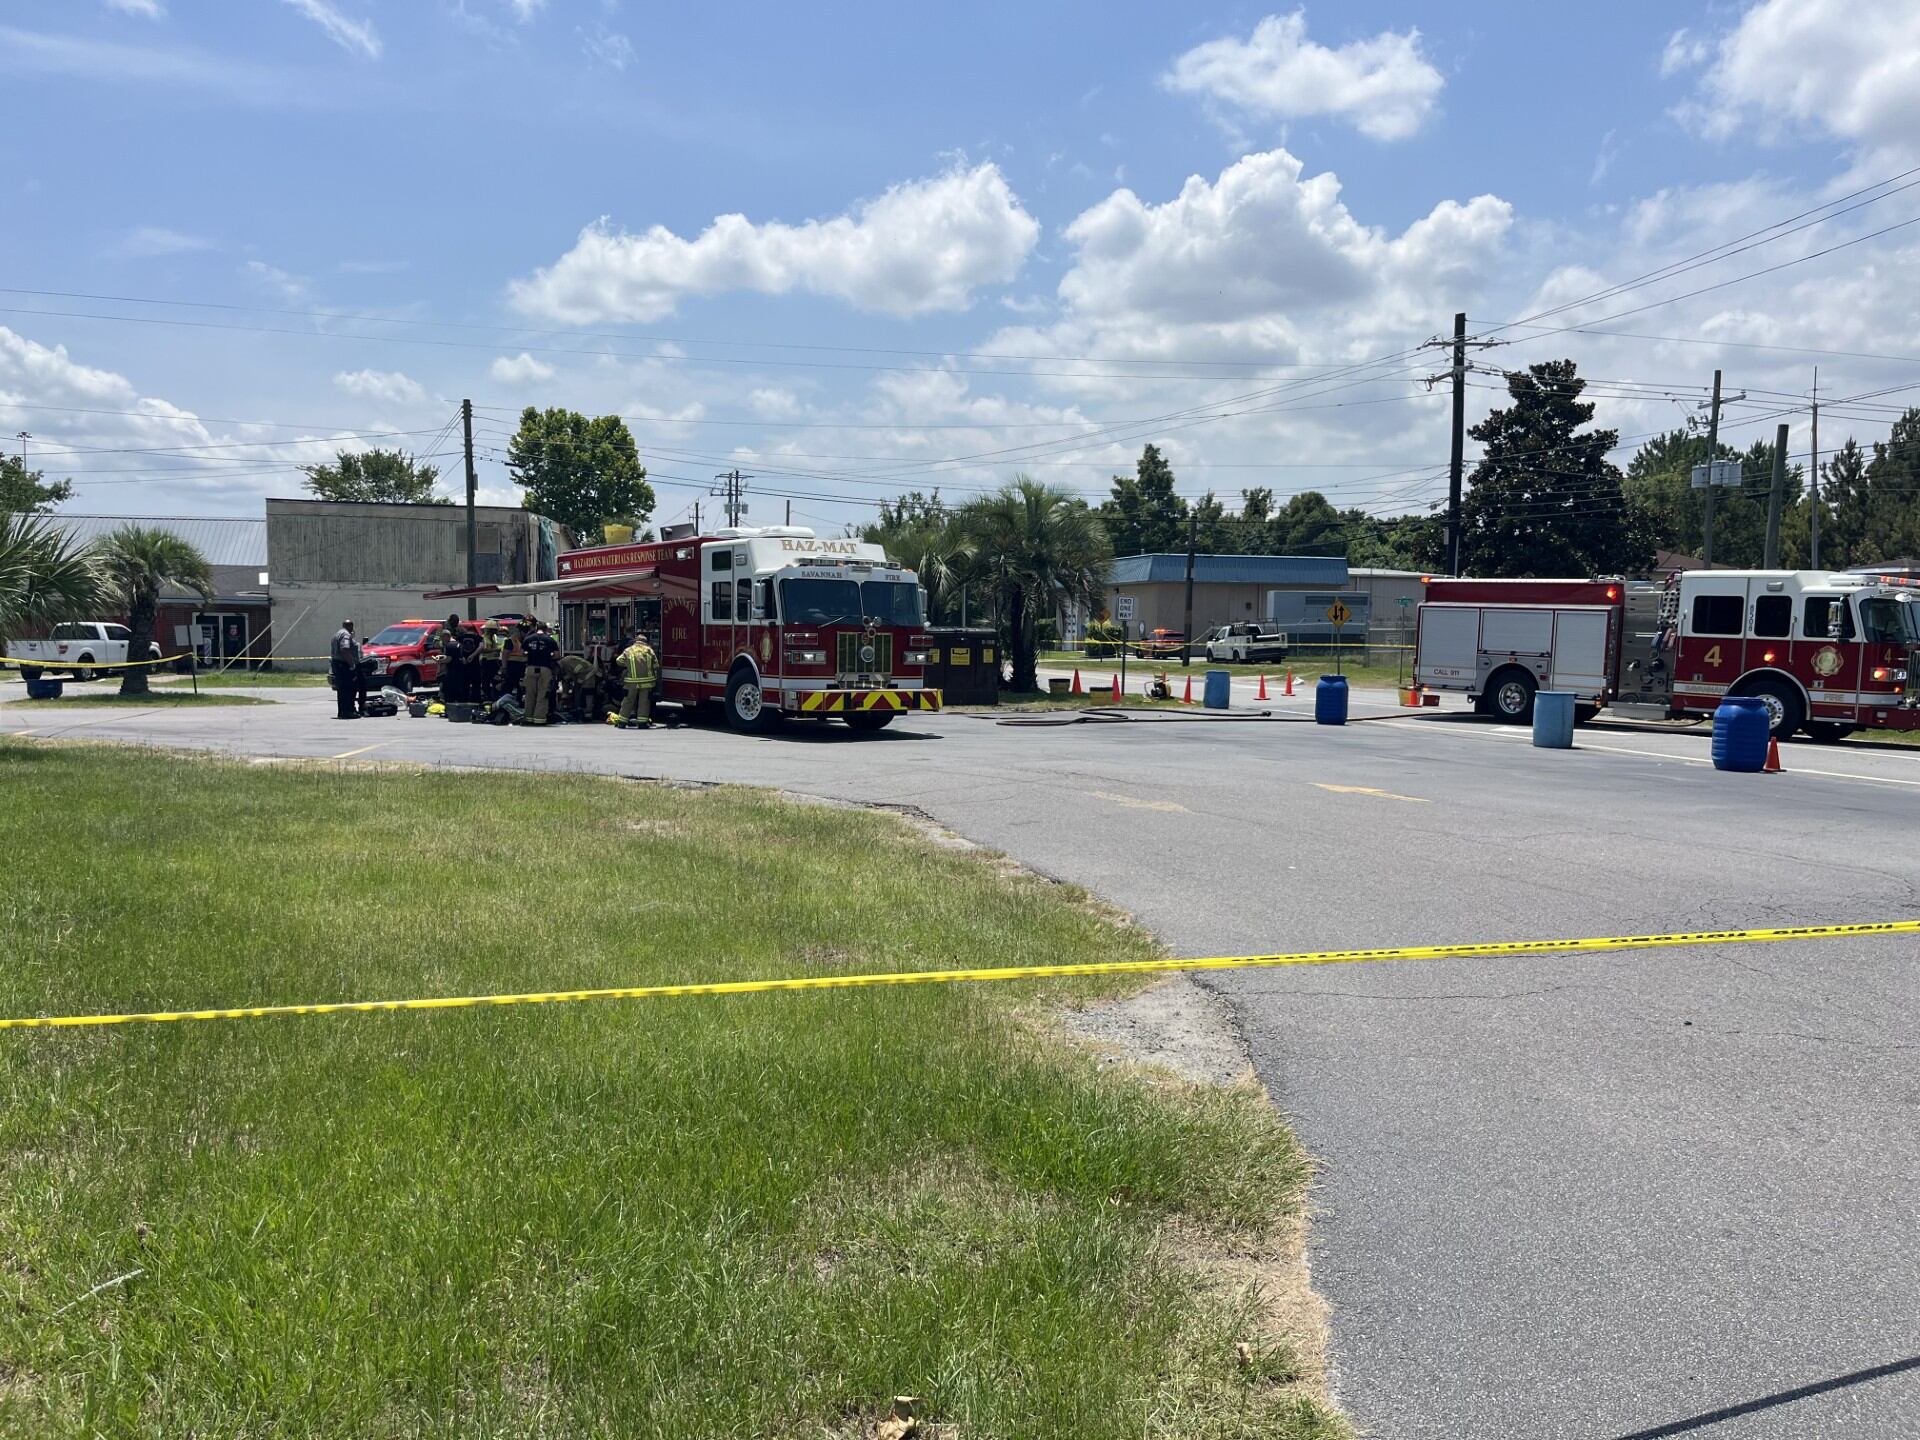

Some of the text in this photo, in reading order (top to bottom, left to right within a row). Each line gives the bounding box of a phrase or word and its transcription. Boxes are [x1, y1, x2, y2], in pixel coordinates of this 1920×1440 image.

[780, 540, 857, 554] HAZ-MAT
[573, 547, 674, 569] HAZARDOUS MATERIALS RESPONSE TEAM
[801, 570, 843, 579] SAVANNAH
[671, 627, 688, 640] FIRE
[1703, 645, 1722, 667] 4
[1884, 648, 1892, 663] 4
[1433, 668, 1449, 676] CALL
